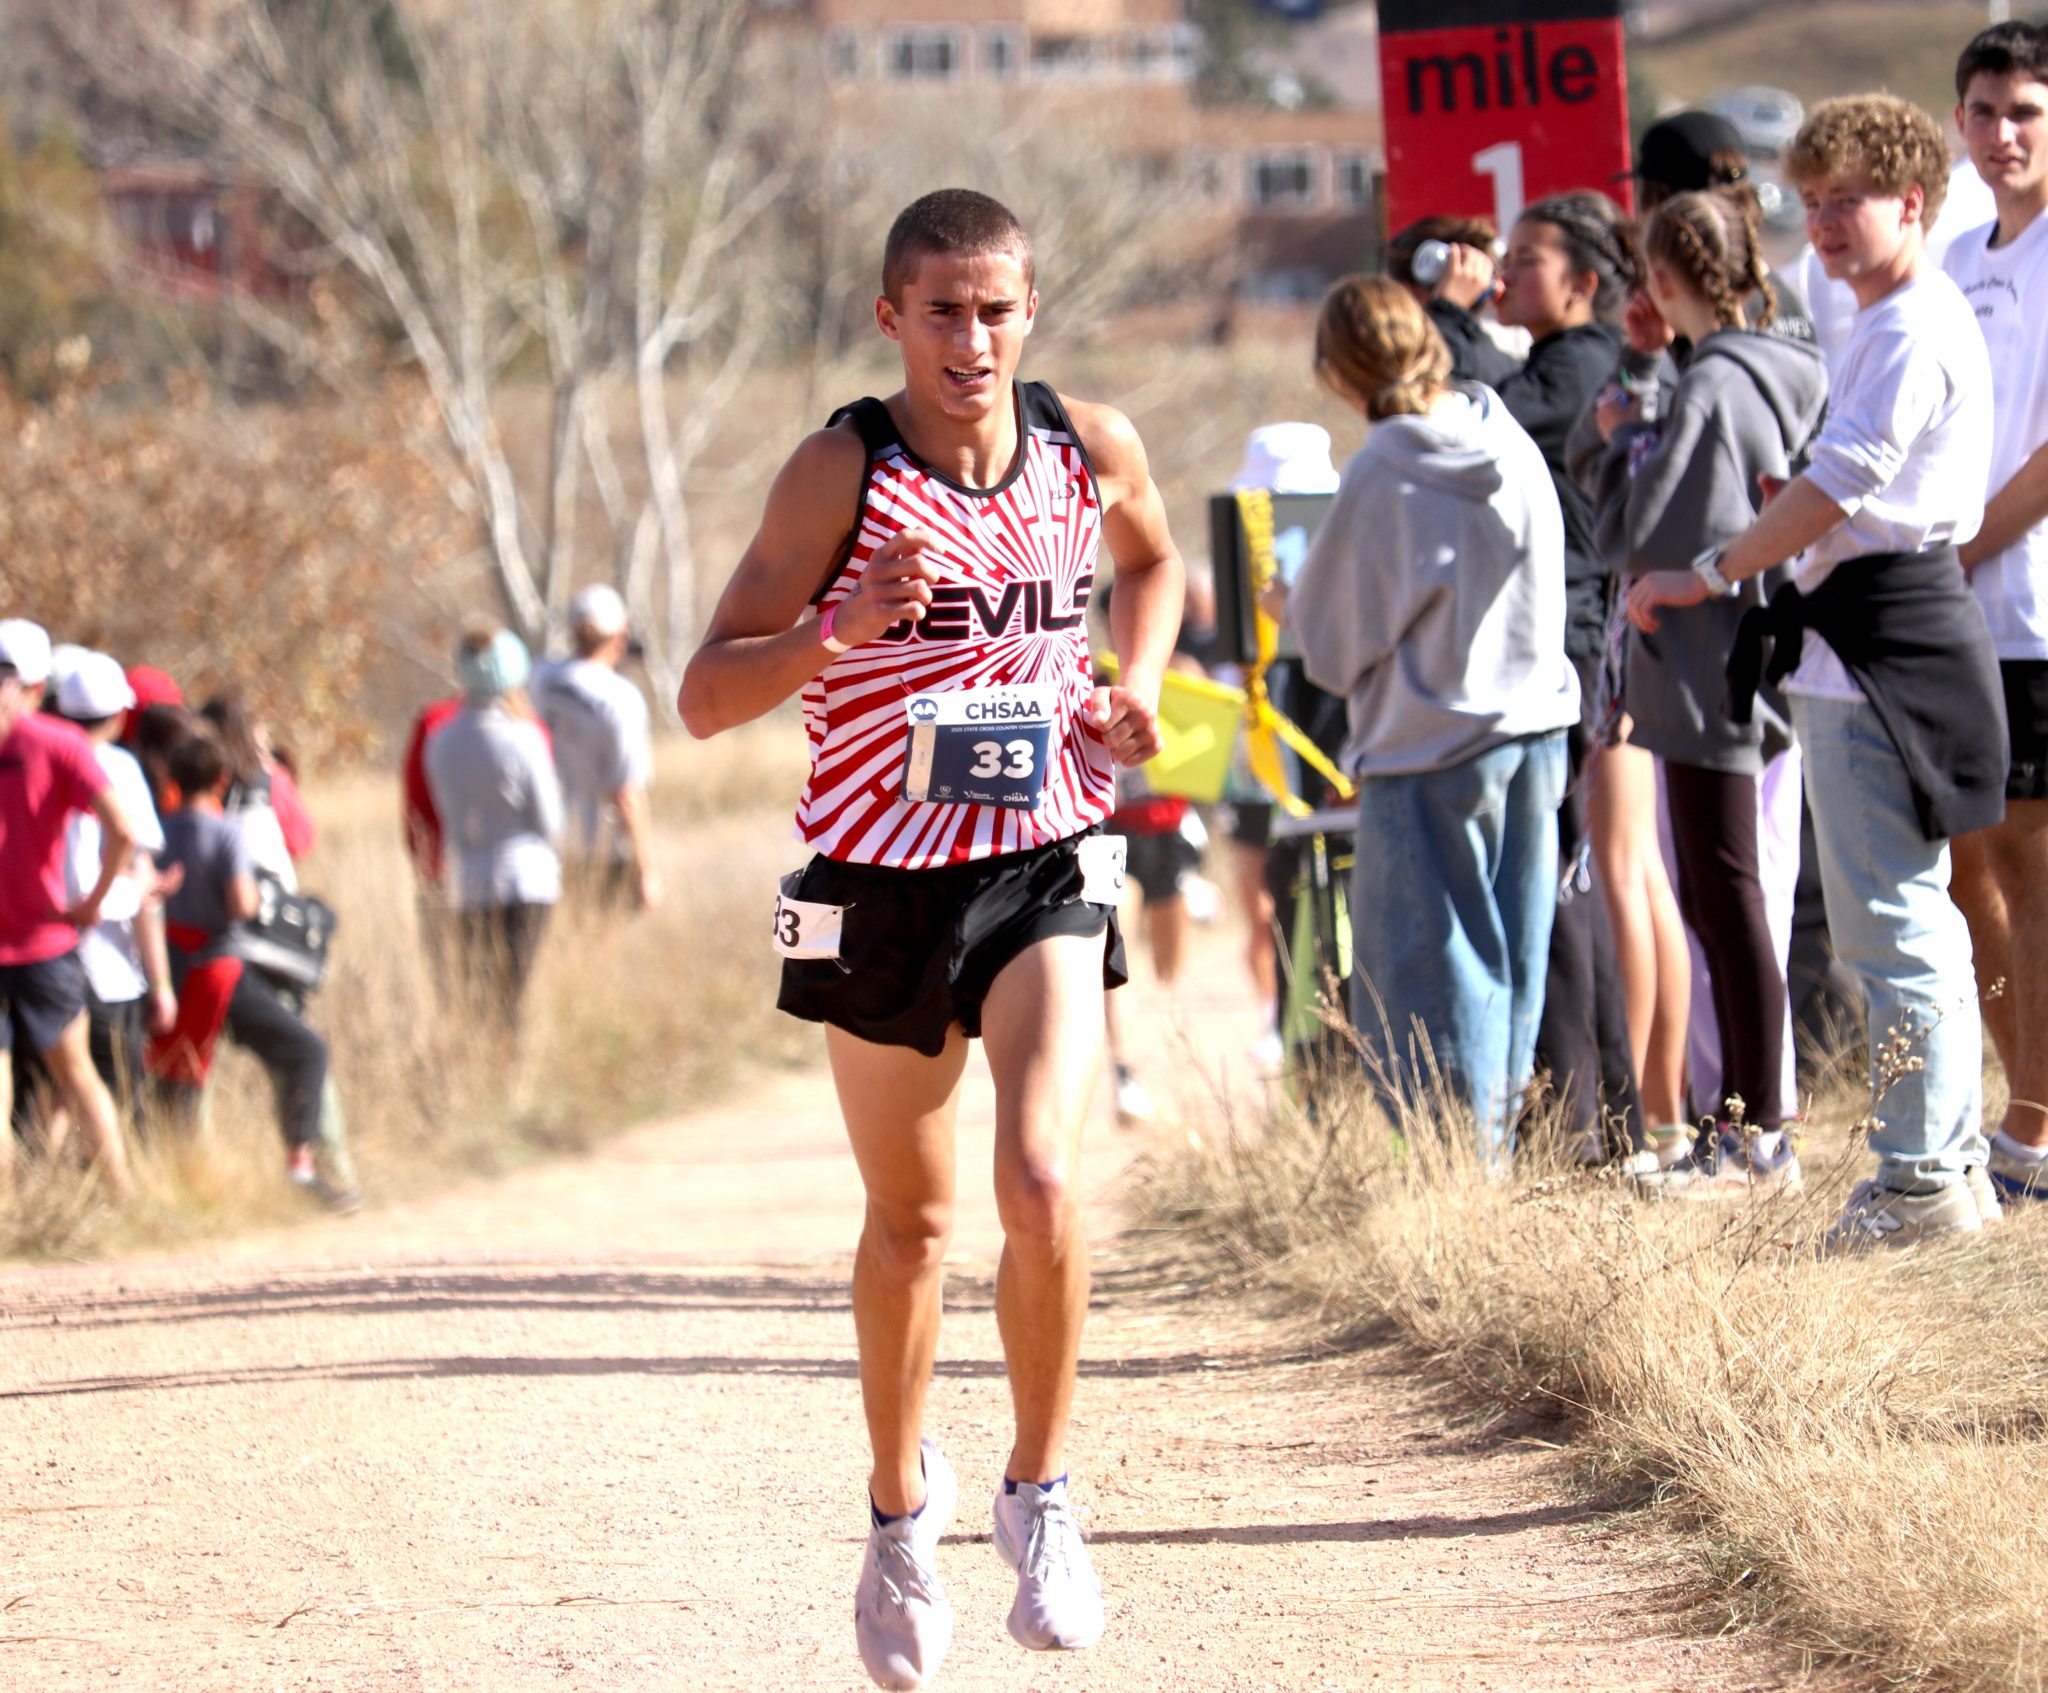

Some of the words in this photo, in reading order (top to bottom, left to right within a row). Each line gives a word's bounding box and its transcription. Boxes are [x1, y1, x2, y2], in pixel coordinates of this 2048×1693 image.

[1406, 29, 1597, 116] mile
[1471, 140, 1526, 240] 1
[965, 701, 1042, 720] CHSAA
[969, 739, 1034, 779] 33
[1003, 794, 1030, 803] CHSAA
